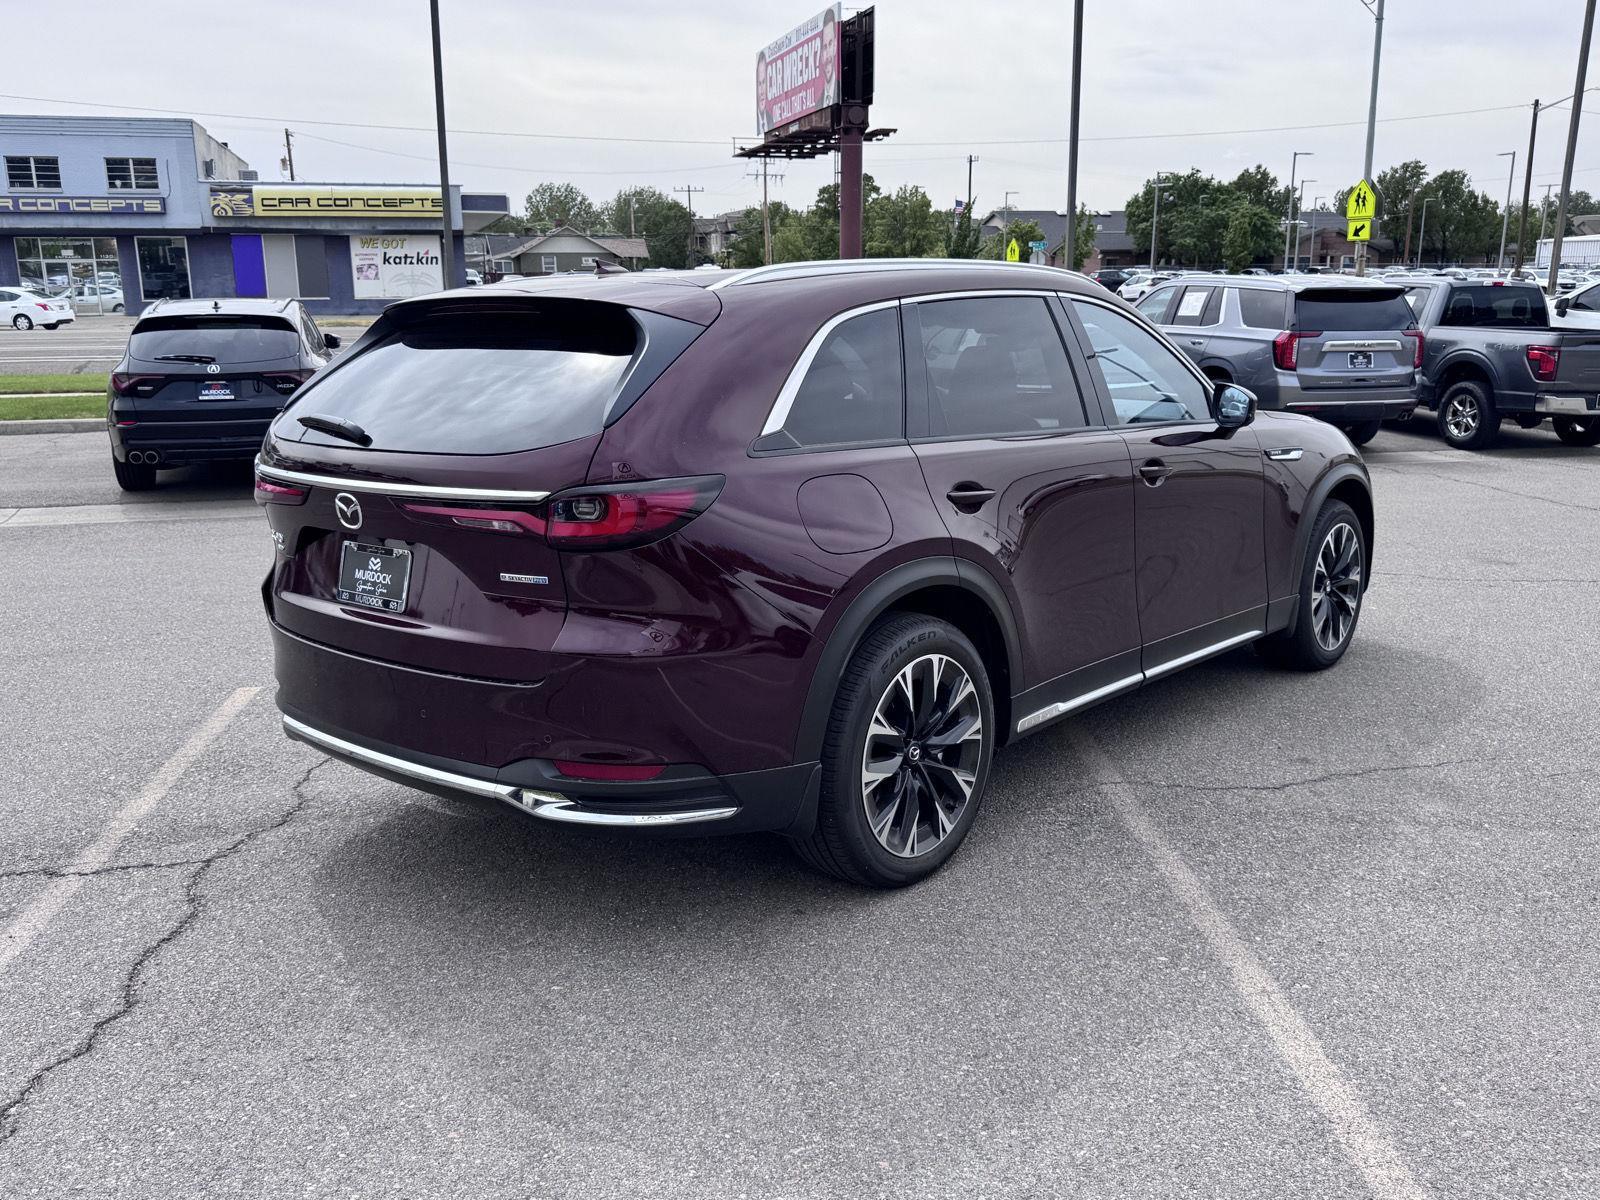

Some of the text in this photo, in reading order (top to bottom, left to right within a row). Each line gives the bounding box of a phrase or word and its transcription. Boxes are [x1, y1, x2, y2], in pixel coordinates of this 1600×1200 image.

[767, 59, 784, 101] CAR
[783, 37, 821, 92] WRECK?
[18, 198, 162, 212] CONCEPTS
[261, 197, 443, 208] CAR CONCEPTS
[360, 237, 407, 250] WE GOT
[383, 249, 439, 266] katzkin
[354, 568, 392, 585] MURDOCK
[354, 594, 383, 607] MURDOCK
[881, 631, 937, 674] FALKEN
